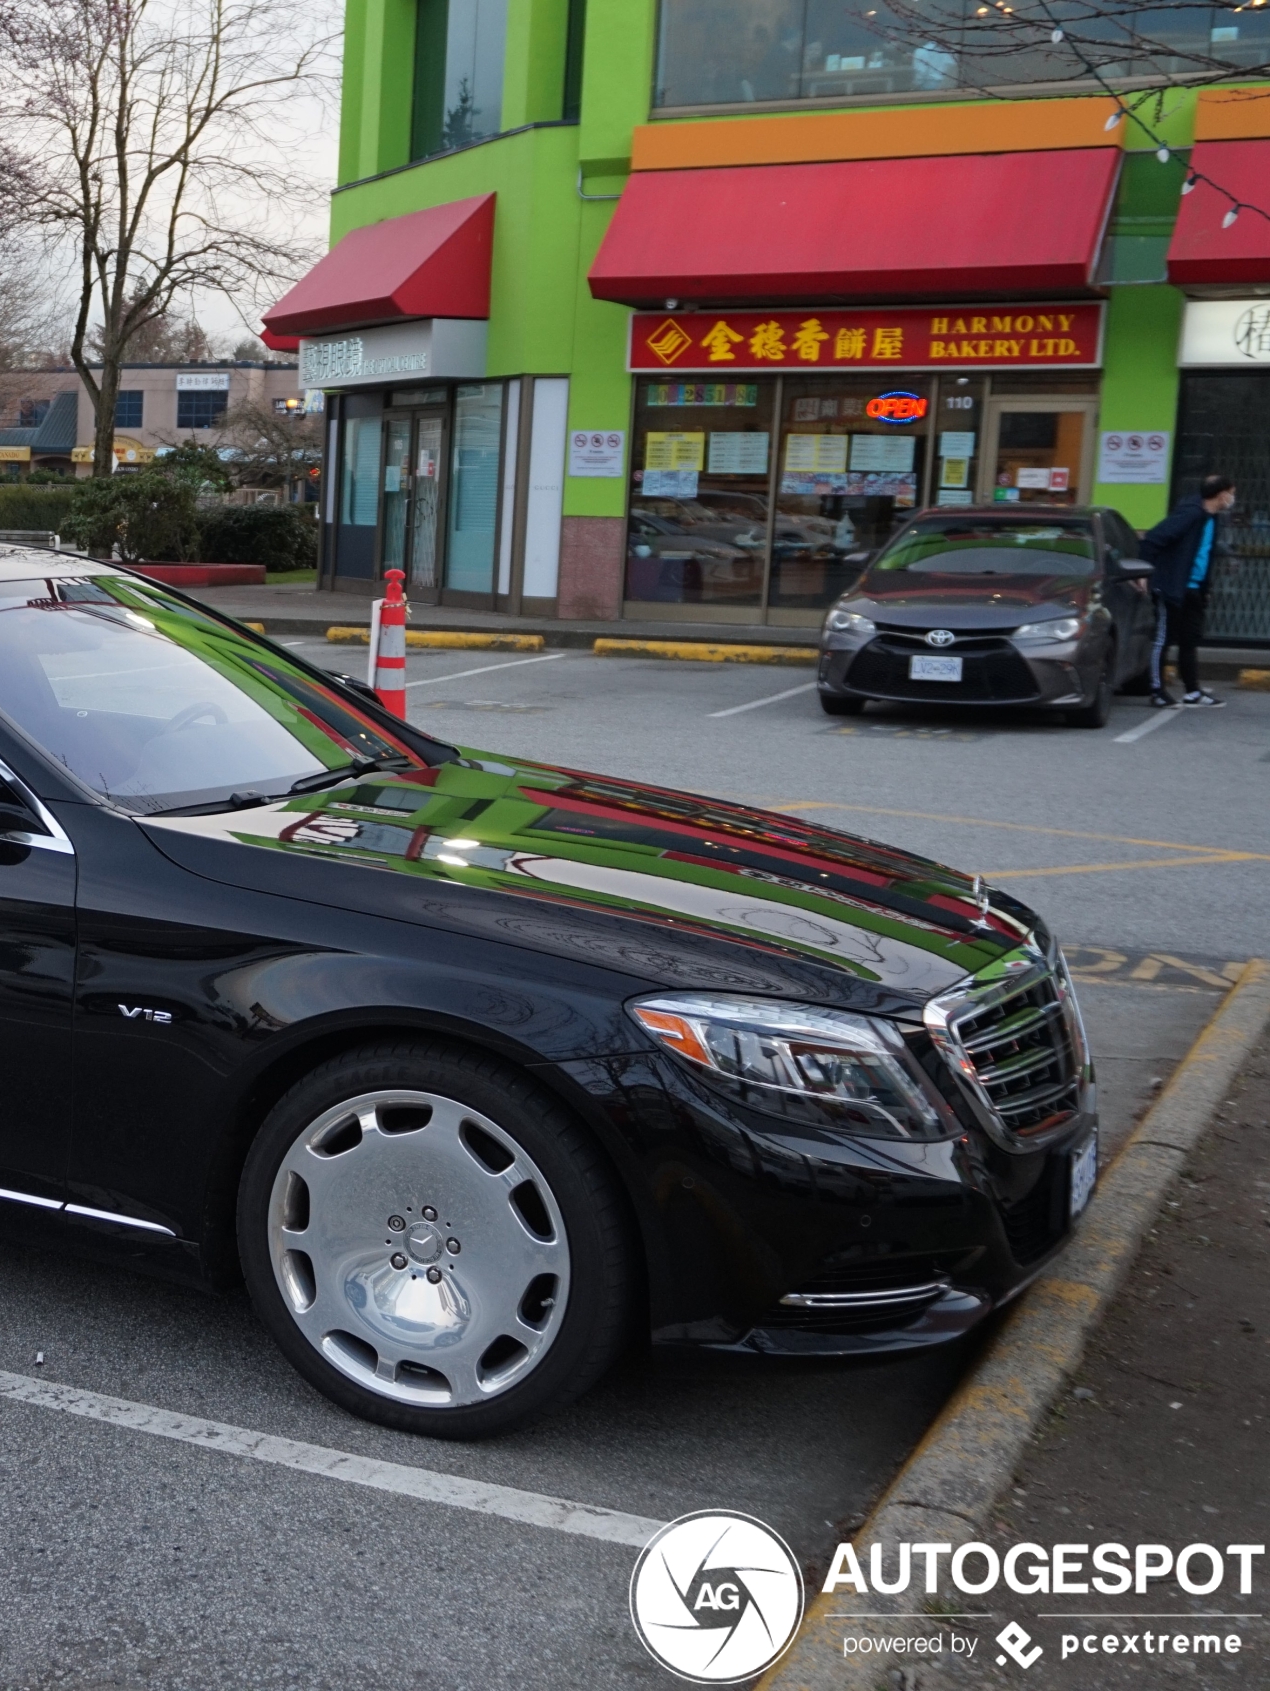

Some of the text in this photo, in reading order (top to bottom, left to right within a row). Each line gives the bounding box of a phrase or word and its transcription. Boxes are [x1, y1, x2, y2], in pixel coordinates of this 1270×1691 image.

[930, 314, 1075, 334] HARMONY
[929, 338, 1081, 358] BAKERY LTD.
[866, 398, 927, 418] OPEN
[946, 396, 973, 409] 110
[117, 1004, 172, 1024] V12
